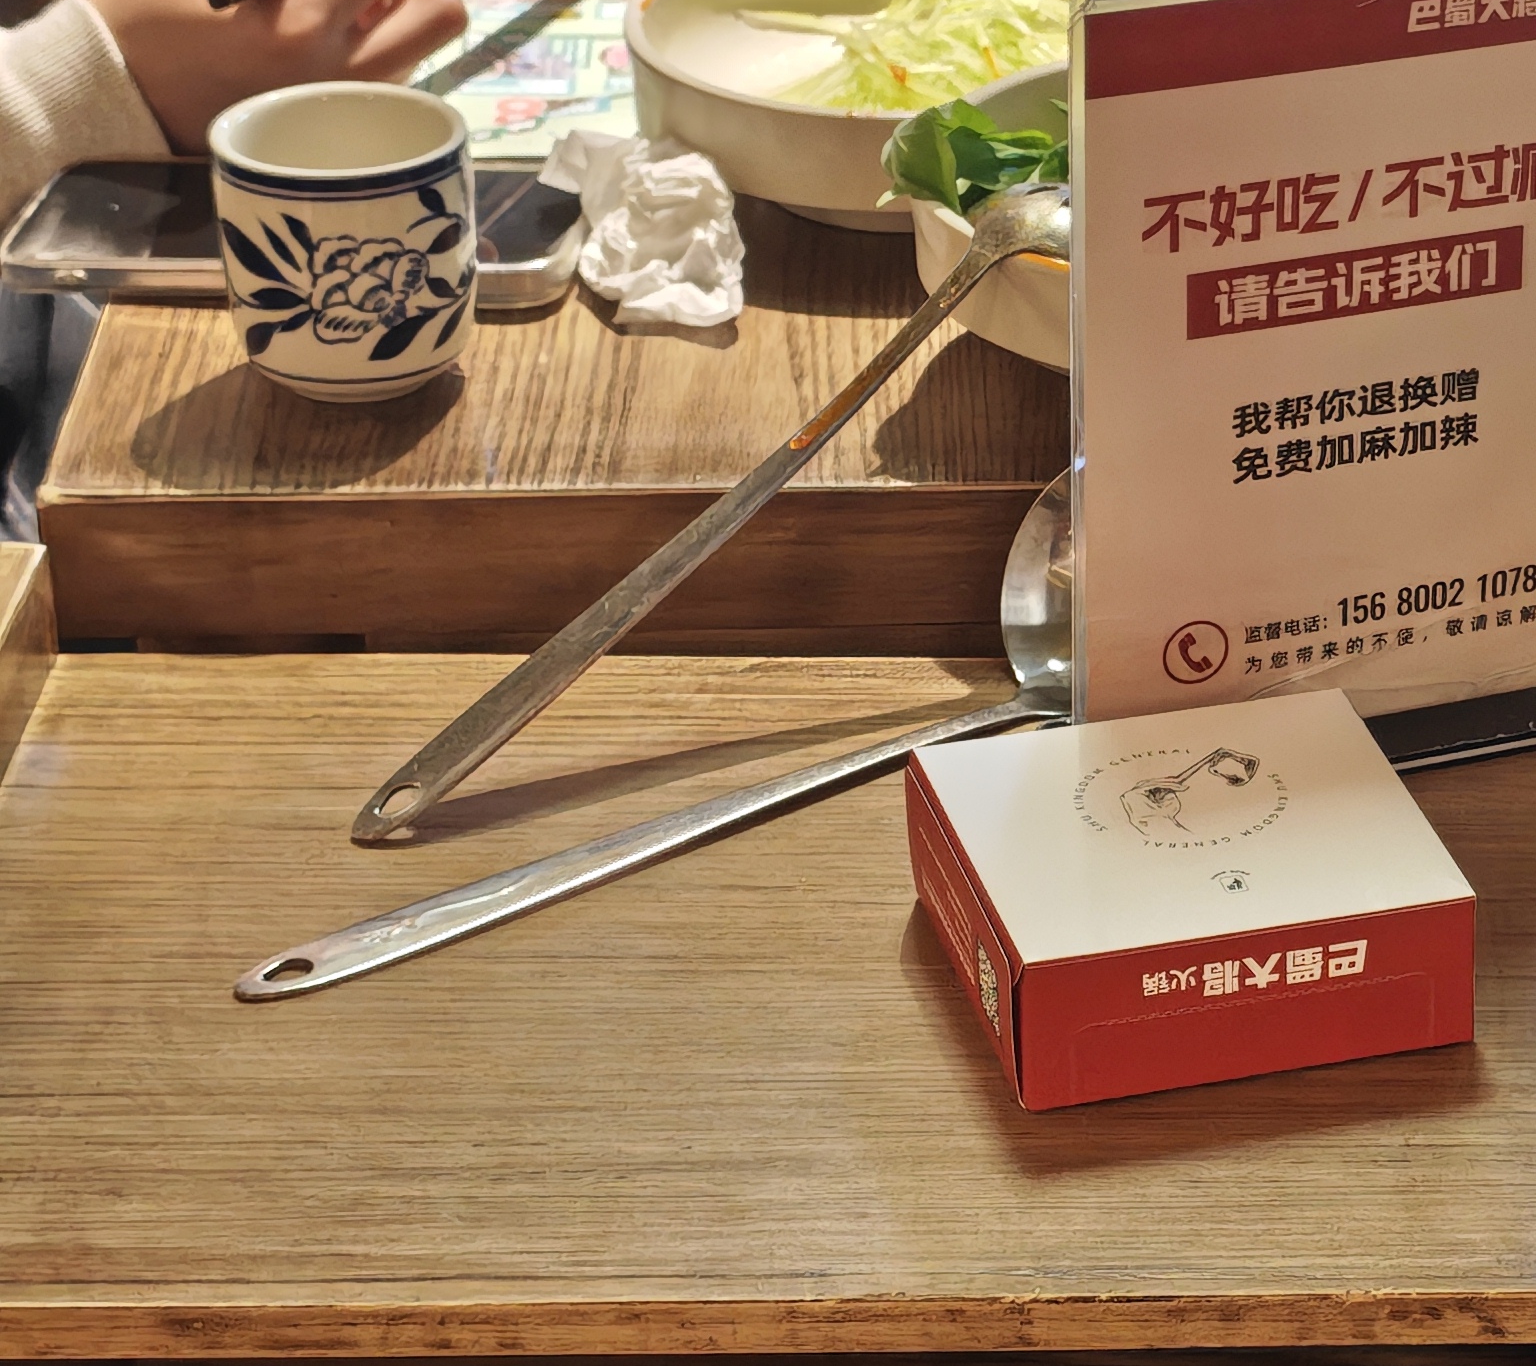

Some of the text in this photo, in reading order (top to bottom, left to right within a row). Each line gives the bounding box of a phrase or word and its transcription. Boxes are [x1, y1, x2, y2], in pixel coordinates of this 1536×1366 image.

[1213, 240, 1499, 329] 请告诉我们
[1231, 367, 1481, 440] 我帮你退换赠
[1231, 413, 1481, 486] 免费加麻加辣
[1337, 592, 1387, 628] 156
[1396, 578, 1467, 621] 8002
